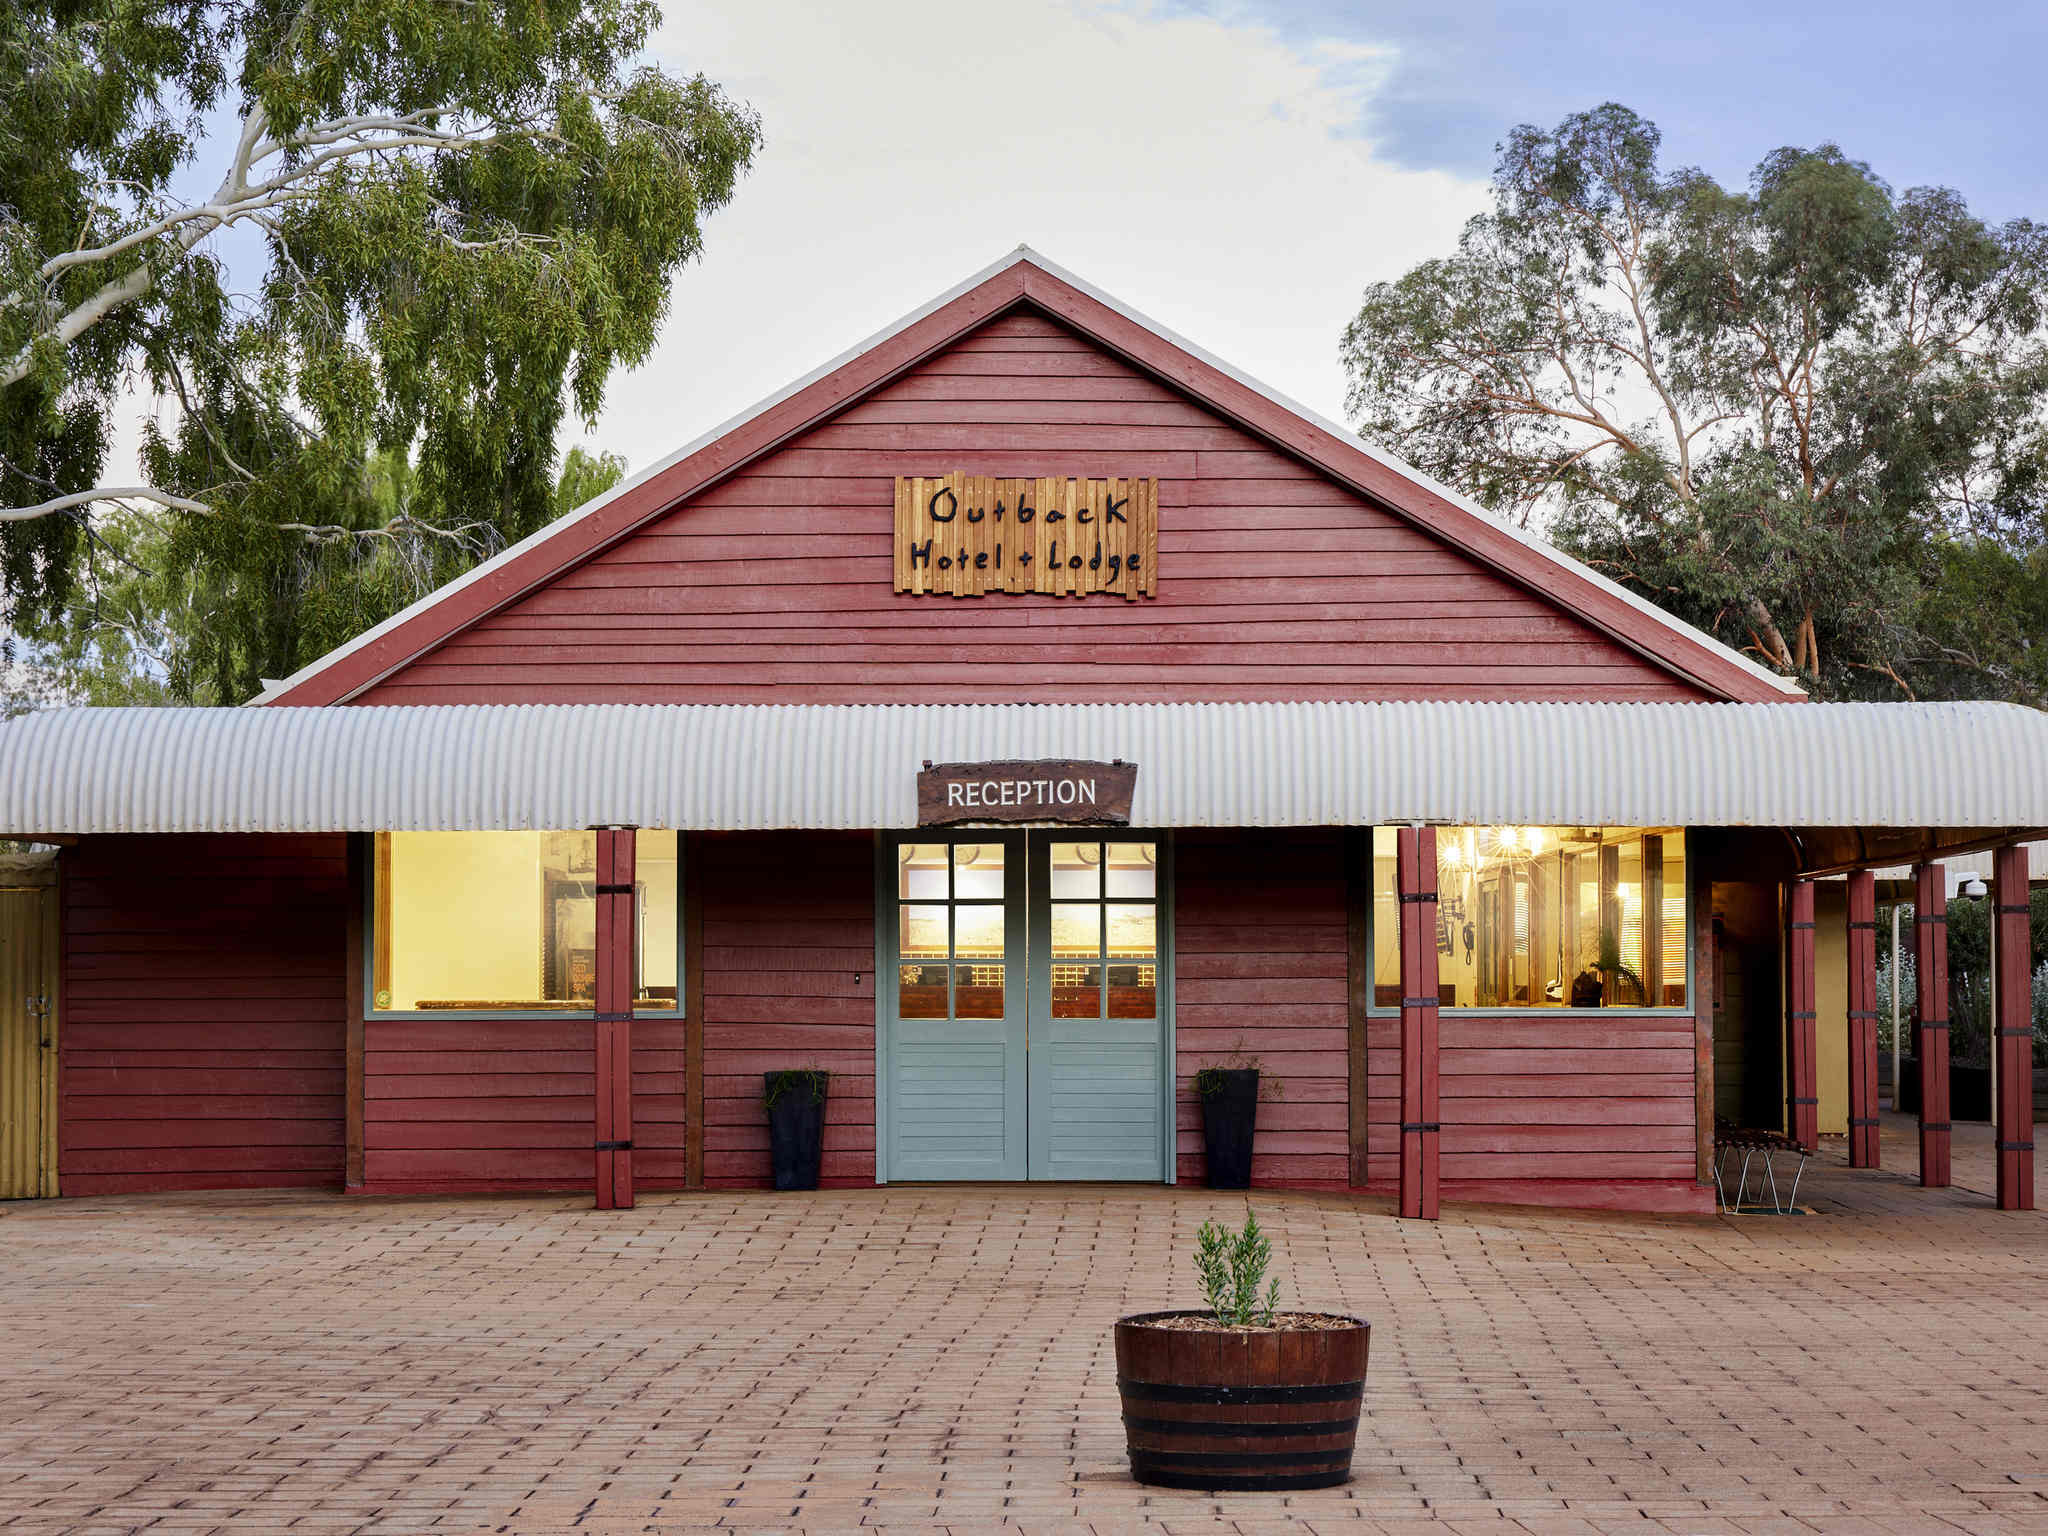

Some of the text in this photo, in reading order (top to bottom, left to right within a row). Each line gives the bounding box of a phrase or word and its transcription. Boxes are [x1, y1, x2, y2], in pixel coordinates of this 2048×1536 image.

[911, 539, 1001, 570] Hotel
[1049, 540, 1141, 585] Lodge
[948, 779, 1096, 807] RECEPTION
